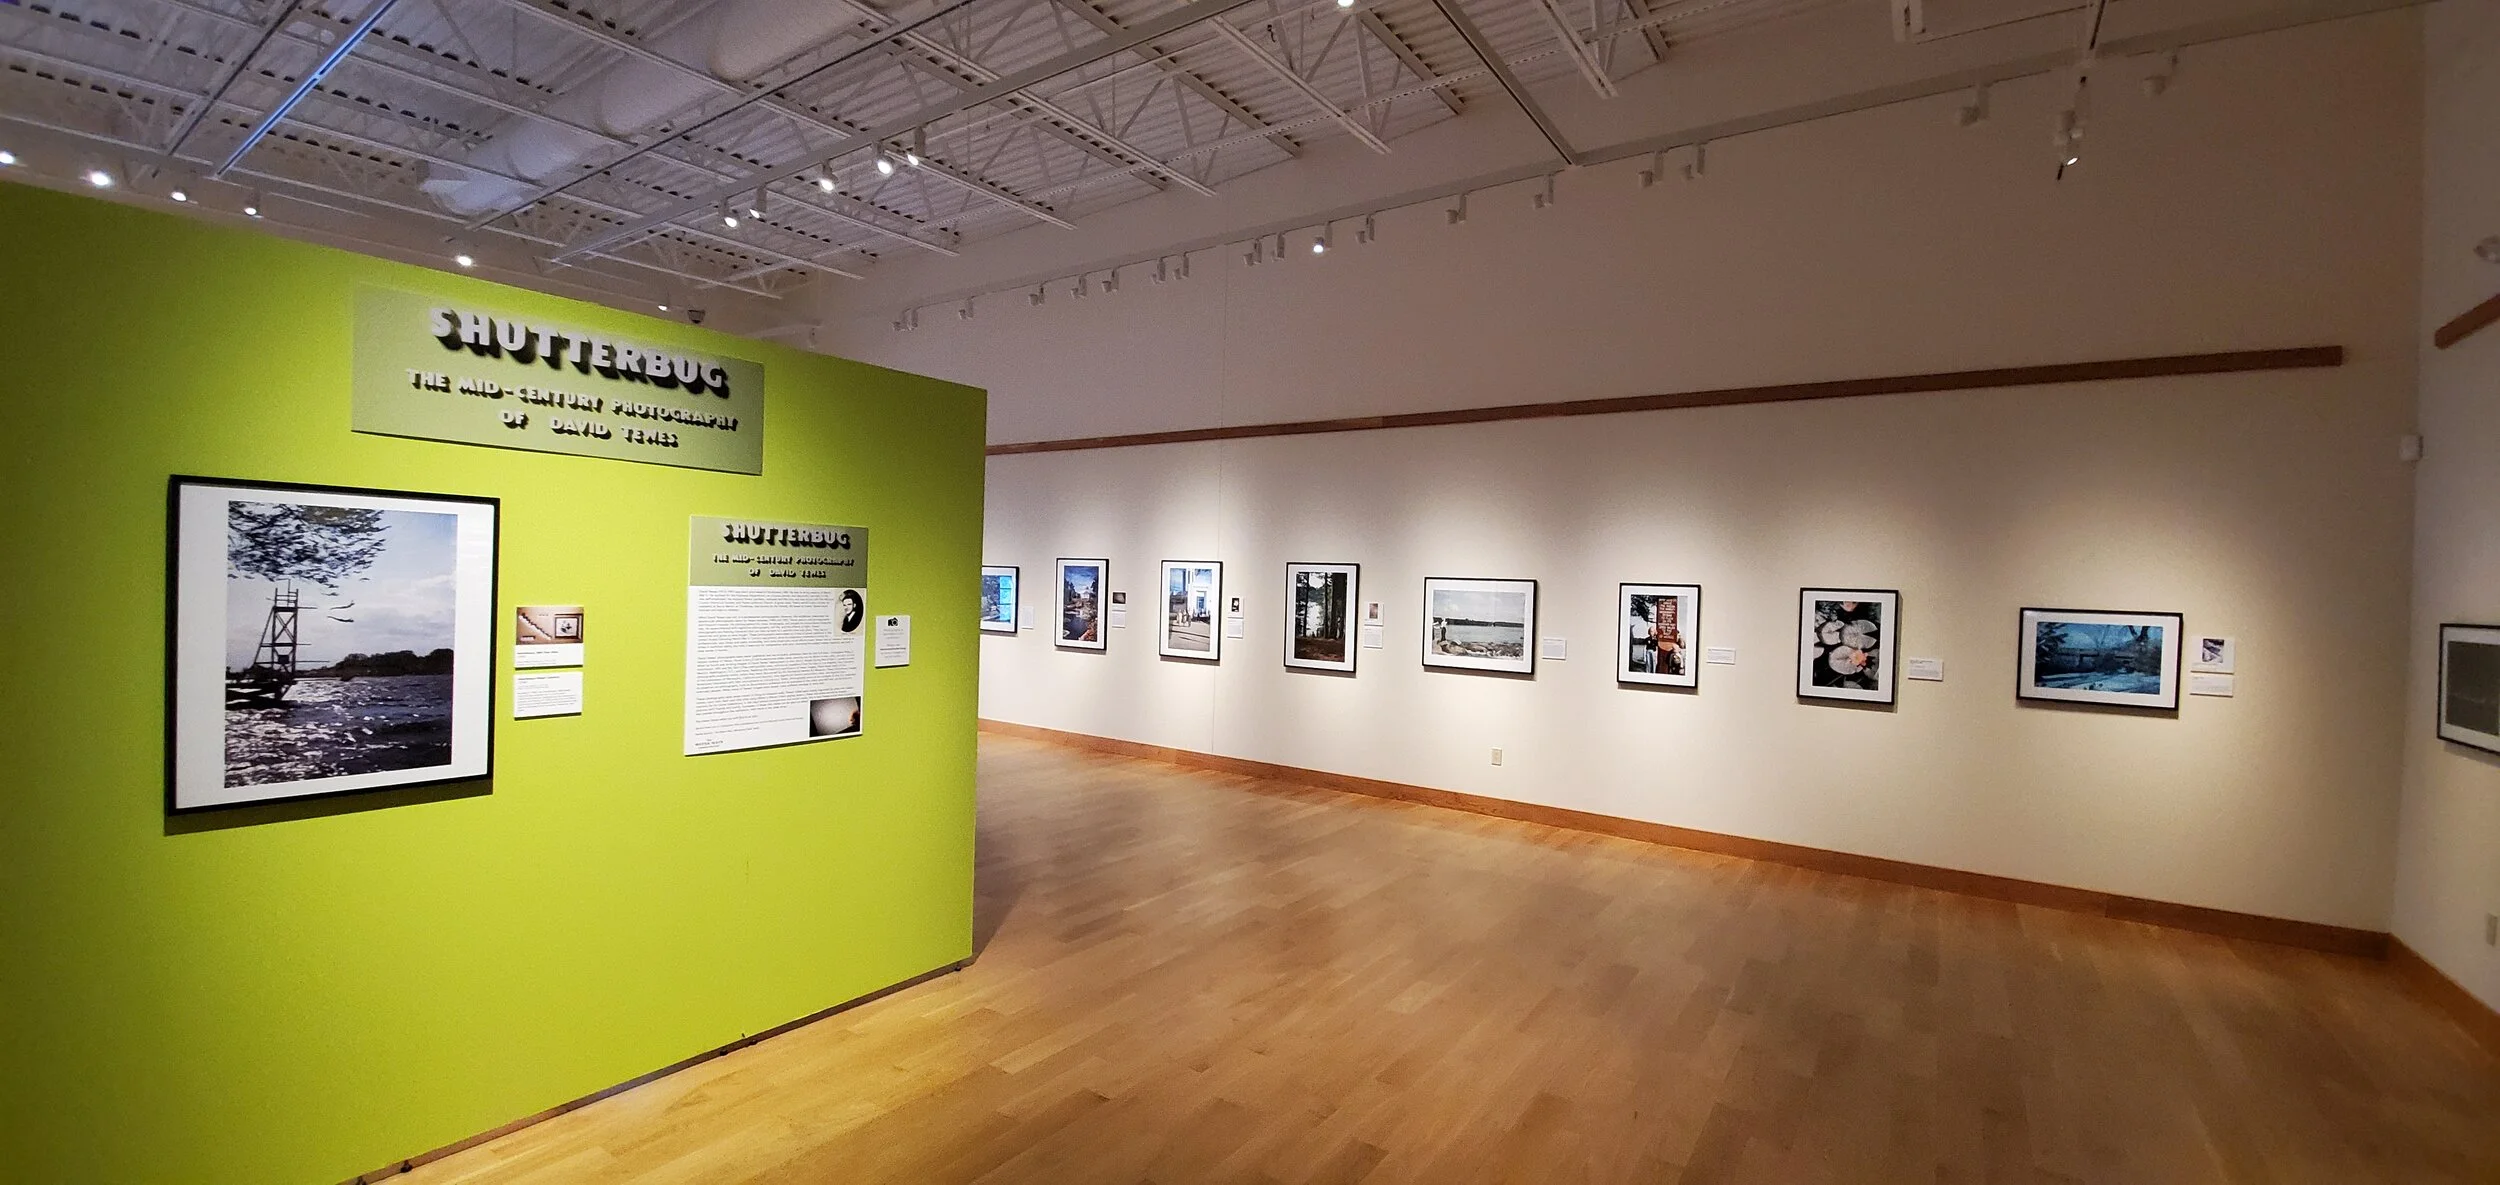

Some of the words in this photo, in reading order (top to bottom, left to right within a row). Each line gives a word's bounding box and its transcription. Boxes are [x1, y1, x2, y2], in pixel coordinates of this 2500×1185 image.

[431, 307, 729, 399] SHUTTERBUG
[406, 368, 450, 392] THE
[458, 376, 604, 413] MID-CENTURY
[611, 399, 738, 432] PHOTOGRAPHY
[499, 409, 528, 430] OF
[551, 416, 612, 440] DAVID
[620, 426, 679, 448] TEWES
[721, 522, 851, 550] SHUTTERBUG
[713, 553, 729, 563] THE
[749, 567, 760, 577] OF
